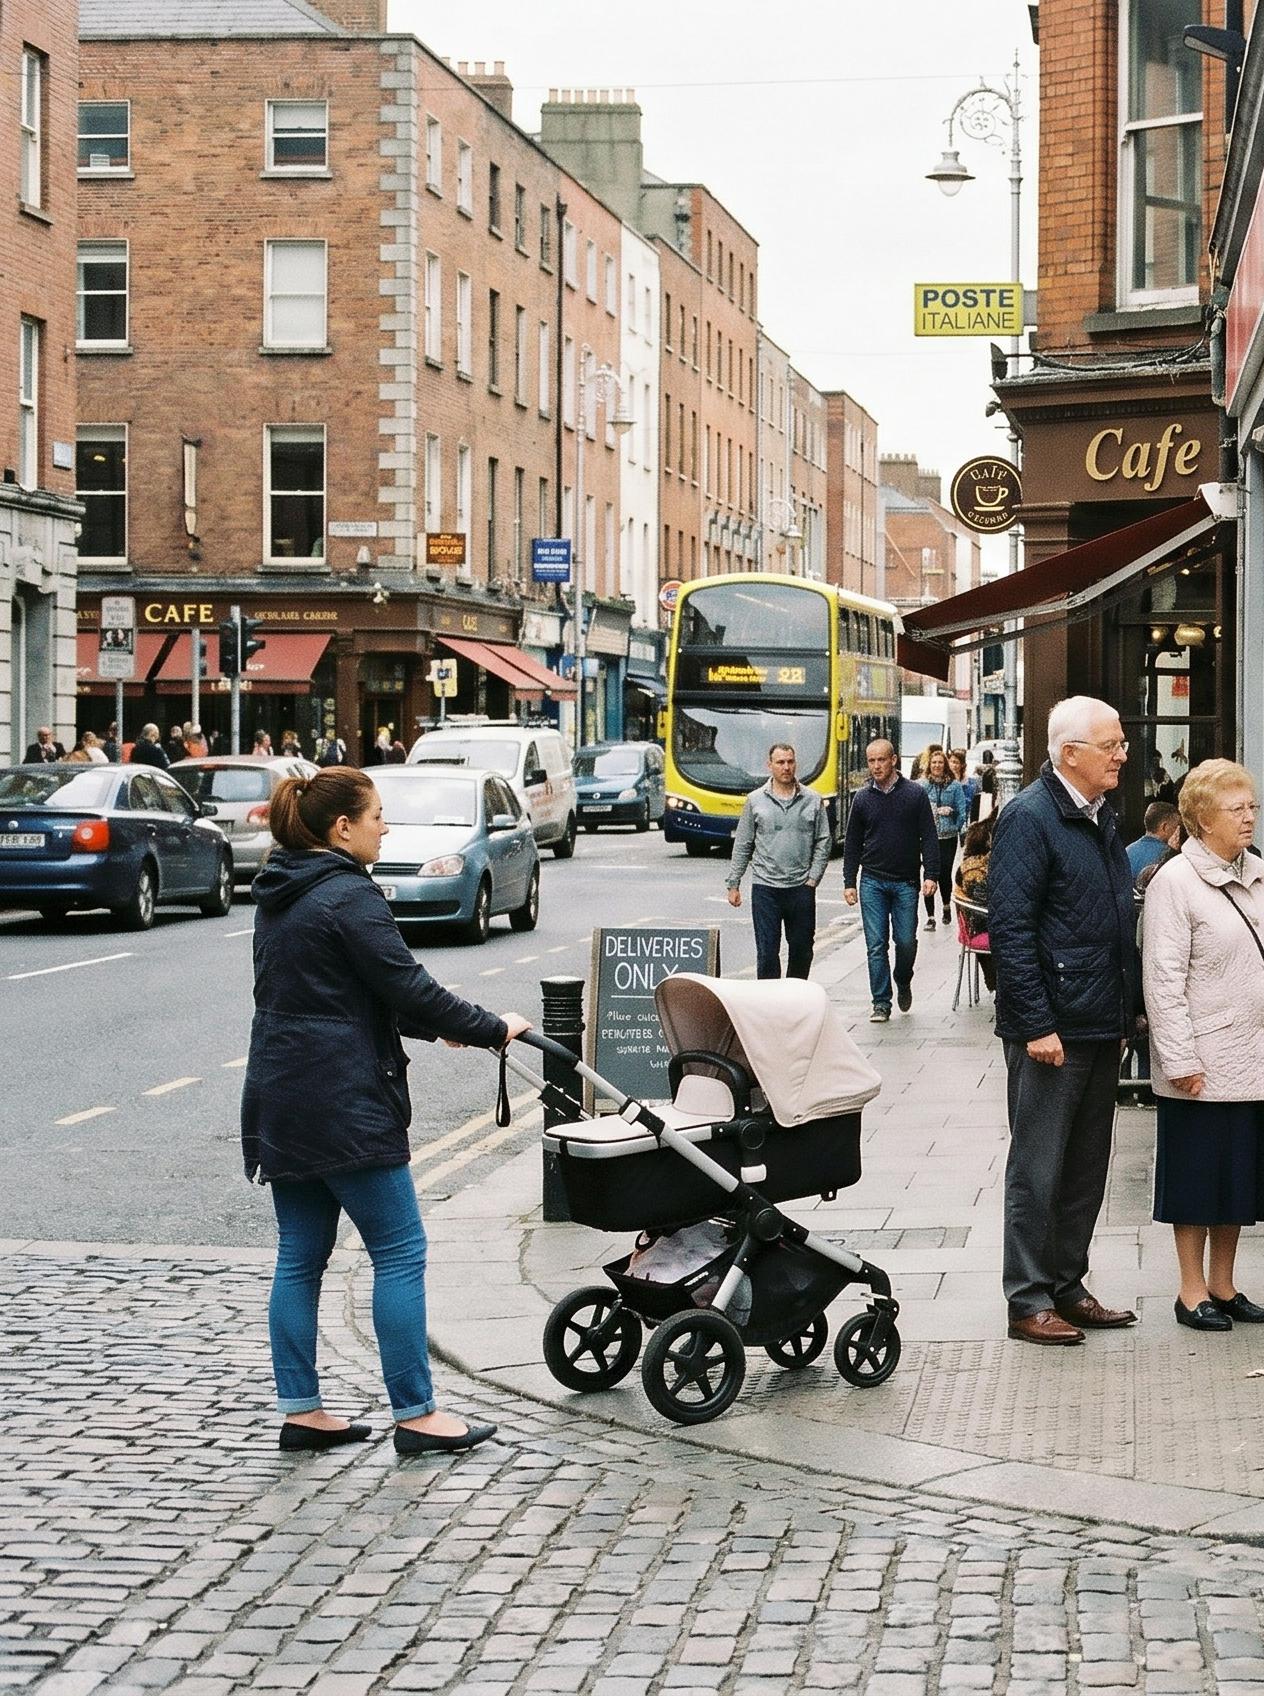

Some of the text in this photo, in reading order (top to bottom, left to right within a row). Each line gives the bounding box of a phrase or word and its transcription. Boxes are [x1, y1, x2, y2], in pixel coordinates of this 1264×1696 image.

[922, 288, 1015, 309] POSTE
[922, 311, 1015, 330] ITALIANE
[1085, 423, 1201, 492] Cafe
[144, 603, 214, 623] CAFE
[605, 936, 703, 959] DELIVERIES
